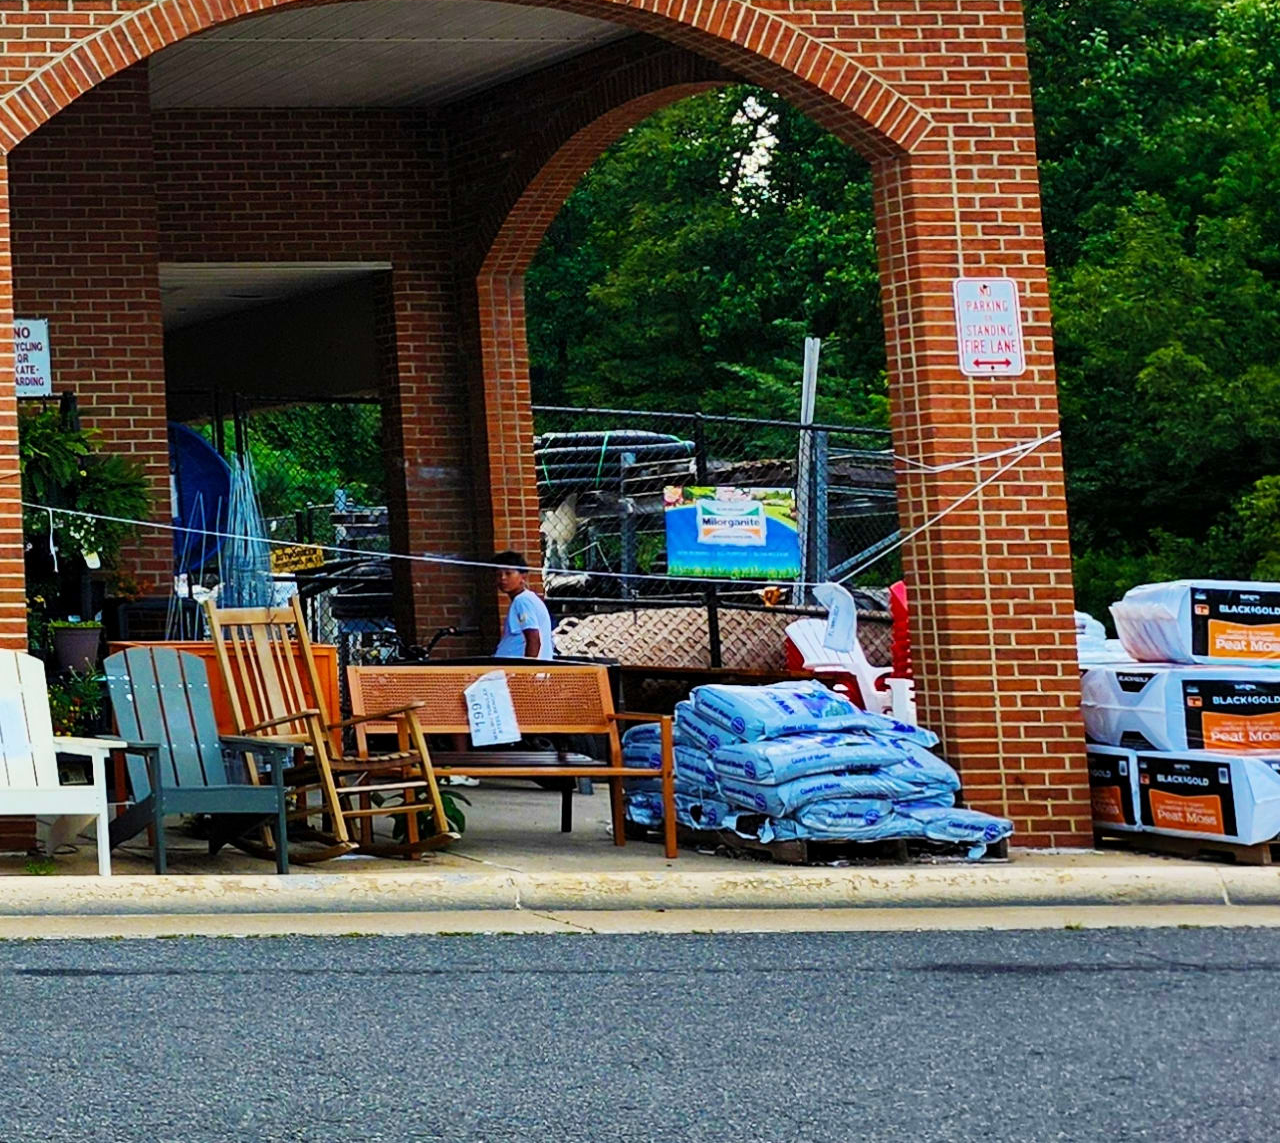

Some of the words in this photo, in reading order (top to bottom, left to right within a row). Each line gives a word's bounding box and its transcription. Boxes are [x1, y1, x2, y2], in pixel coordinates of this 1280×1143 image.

[965, 300, 1009, 312] PARKING
[14, 326, 31, 339] NO
[966, 324, 1014, 337] STANDING
[15, 341, 43, 352] YCLING
[965, 339, 987, 354] FIRE
[990, 339, 1018, 355] LANE
[17, 353, 29, 363] OR
[15, 364, 40, 375] KATE-
[15, 376, 45, 387] ARDING
[702, 517, 760, 528] Milorganite
[1219, 604, 1251, 614] BLACK
[1254, 605, 1280, 616] GOLD
[1215, 638, 1248, 652] Peat
[1250, 640, 1280, 653] Mos
[1212, 696, 1249, 705] BLACK
[1253, 696, 1280, 705] GOLD
[1211, 730, 1245, 742] Peat
[1248, 730, 1280, 743] Mos
[1157, 774, 1185, 784] BLACK
[1187, 776, 1210, 787] GOLD
[1157, 808, 1184, 822] Peat
[1185, 811, 1218, 826] Moss
